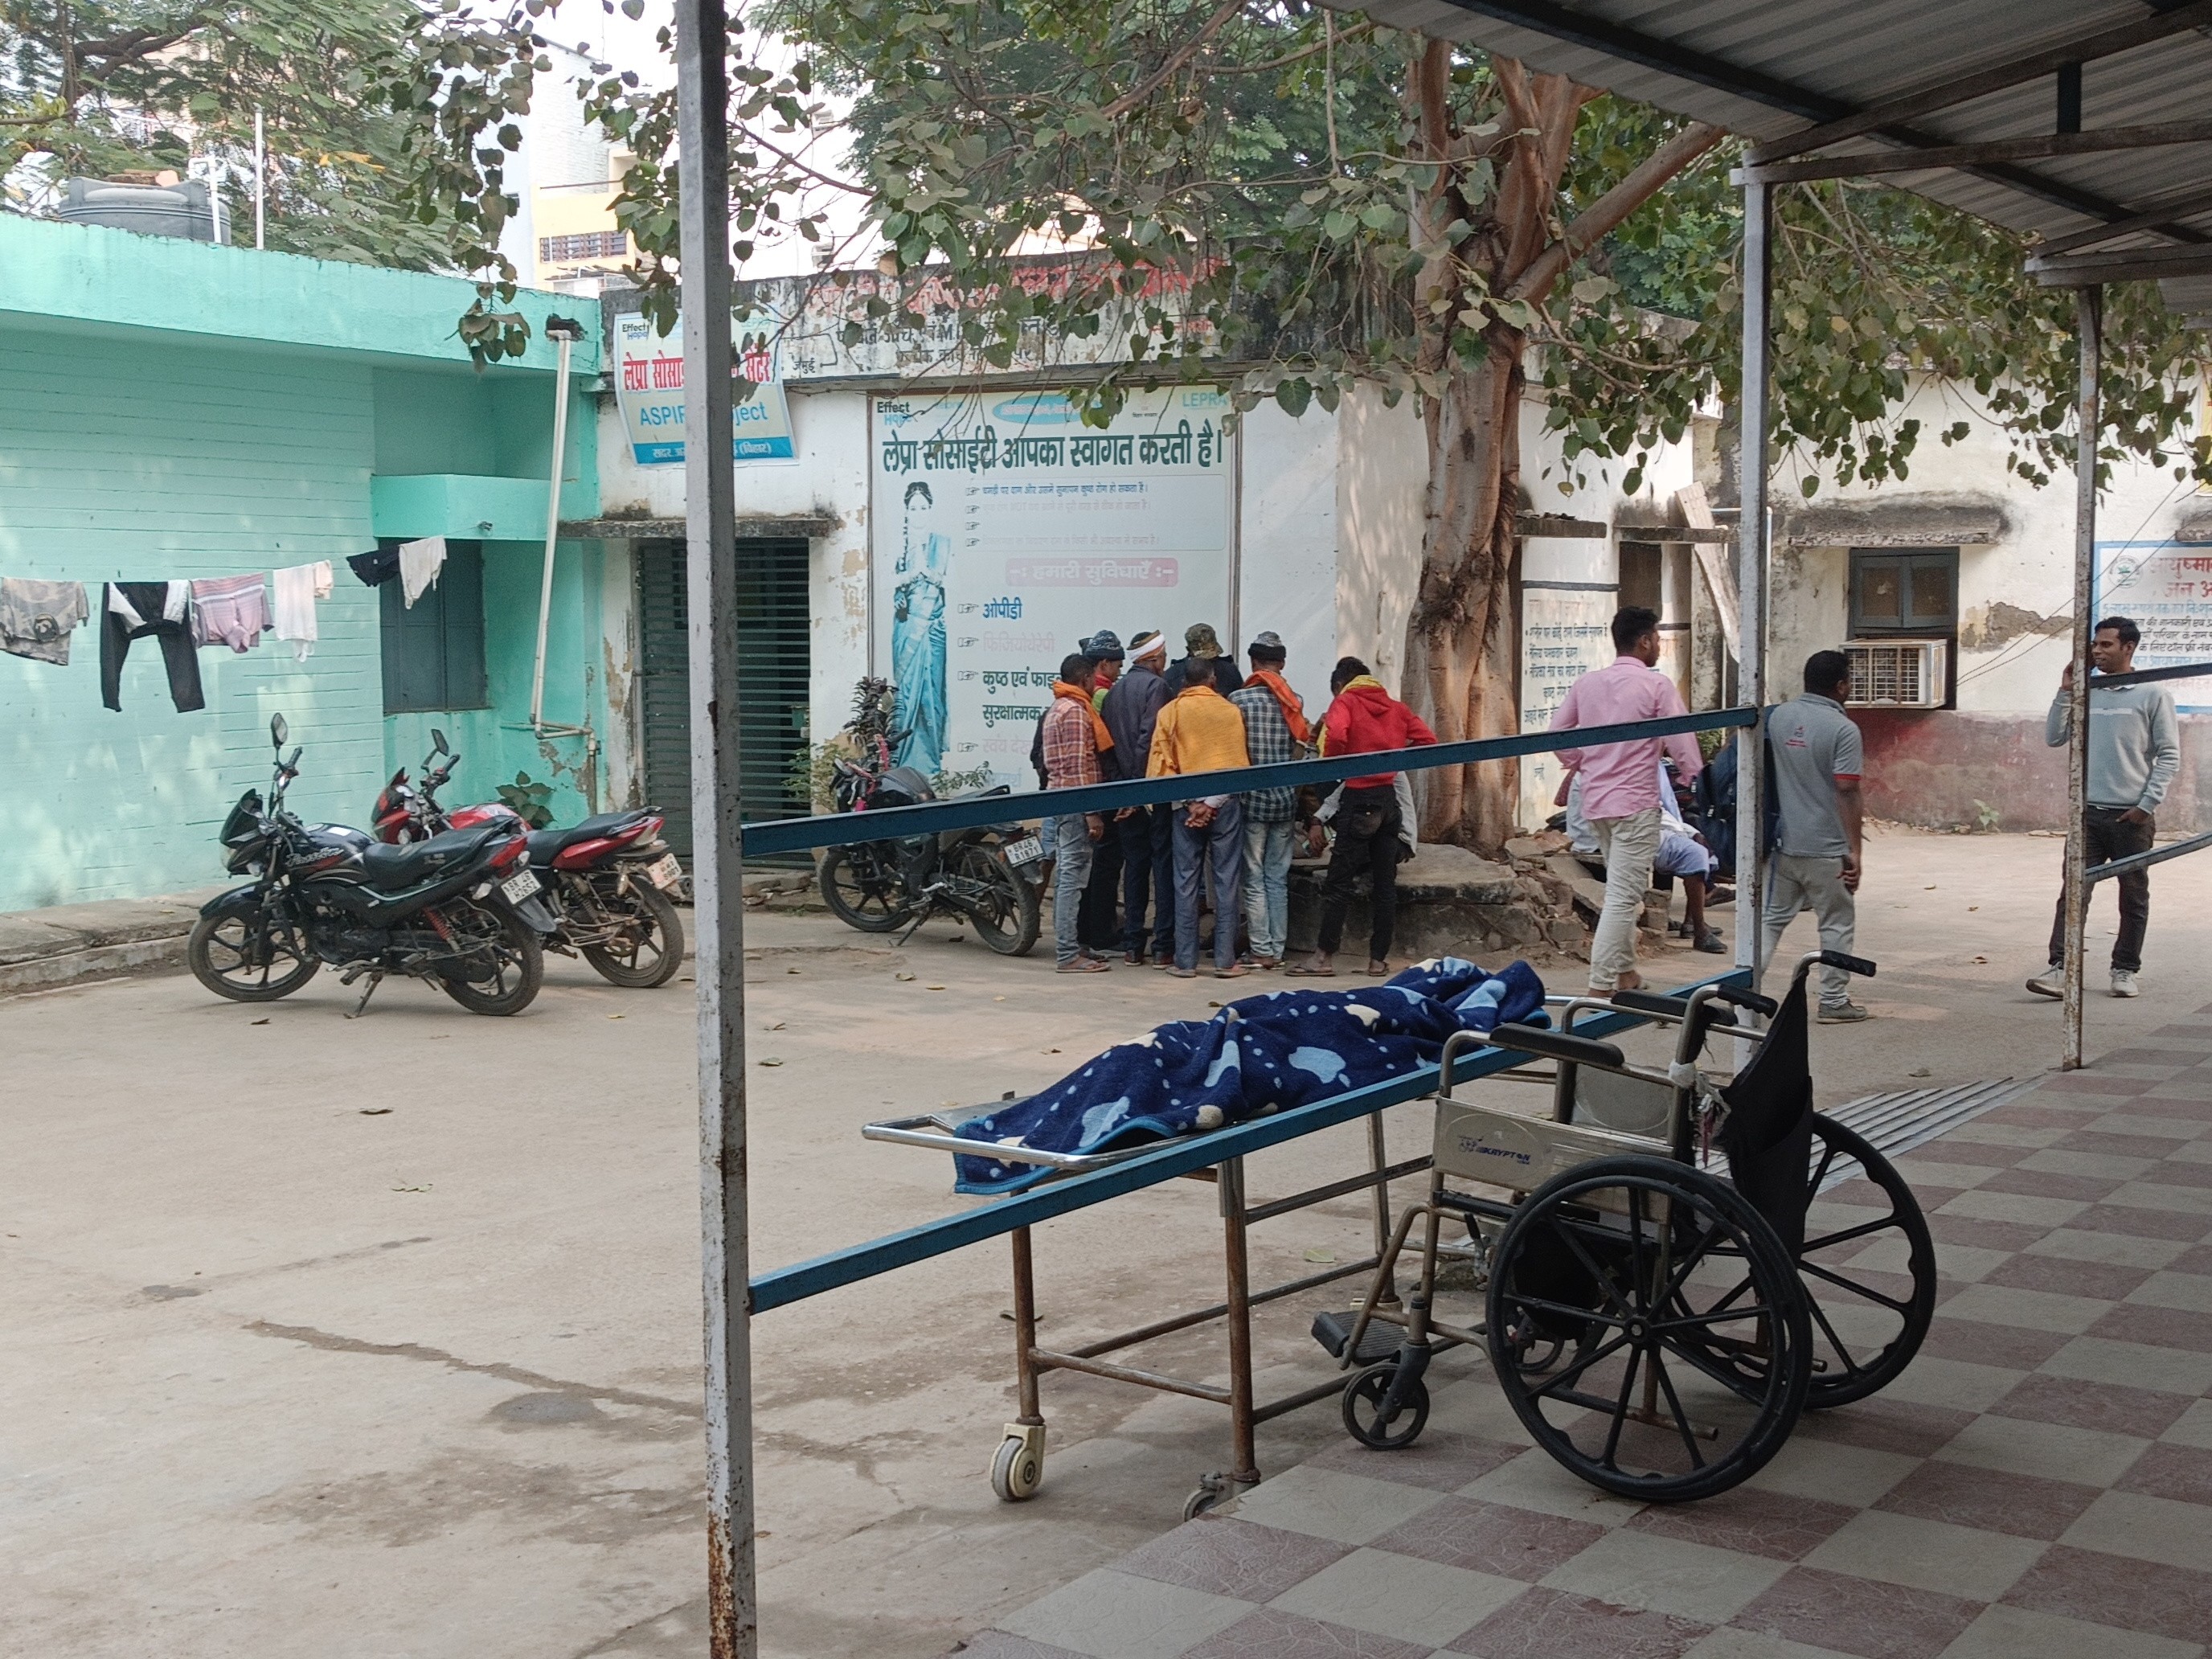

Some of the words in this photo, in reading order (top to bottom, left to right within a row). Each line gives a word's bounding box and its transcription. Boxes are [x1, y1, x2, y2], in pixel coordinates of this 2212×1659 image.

[622, 324, 647, 332] Effect
[623, 351, 648, 391] लेप्रा
[652, 349, 684, 388] सोसा
[734, 402, 768, 426] ject
[877, 402, 910, 413] Effect
[1182, 392, 1228, 408] LEPRA
[883, 429, 918, 476] लेप्रा
[1002, 436, 1065, 469] आपका
[1070, 434, 1134, 468] स्वागत
[1138, 419, 1193, 465] करती
[1032, 560, 1081, 579] हमारी
[983, 596, 1022, 620] ओपीडी
[982, 670, 1009, 694] कुष्ठ
[1010, 666, 1029, 687] एवं
